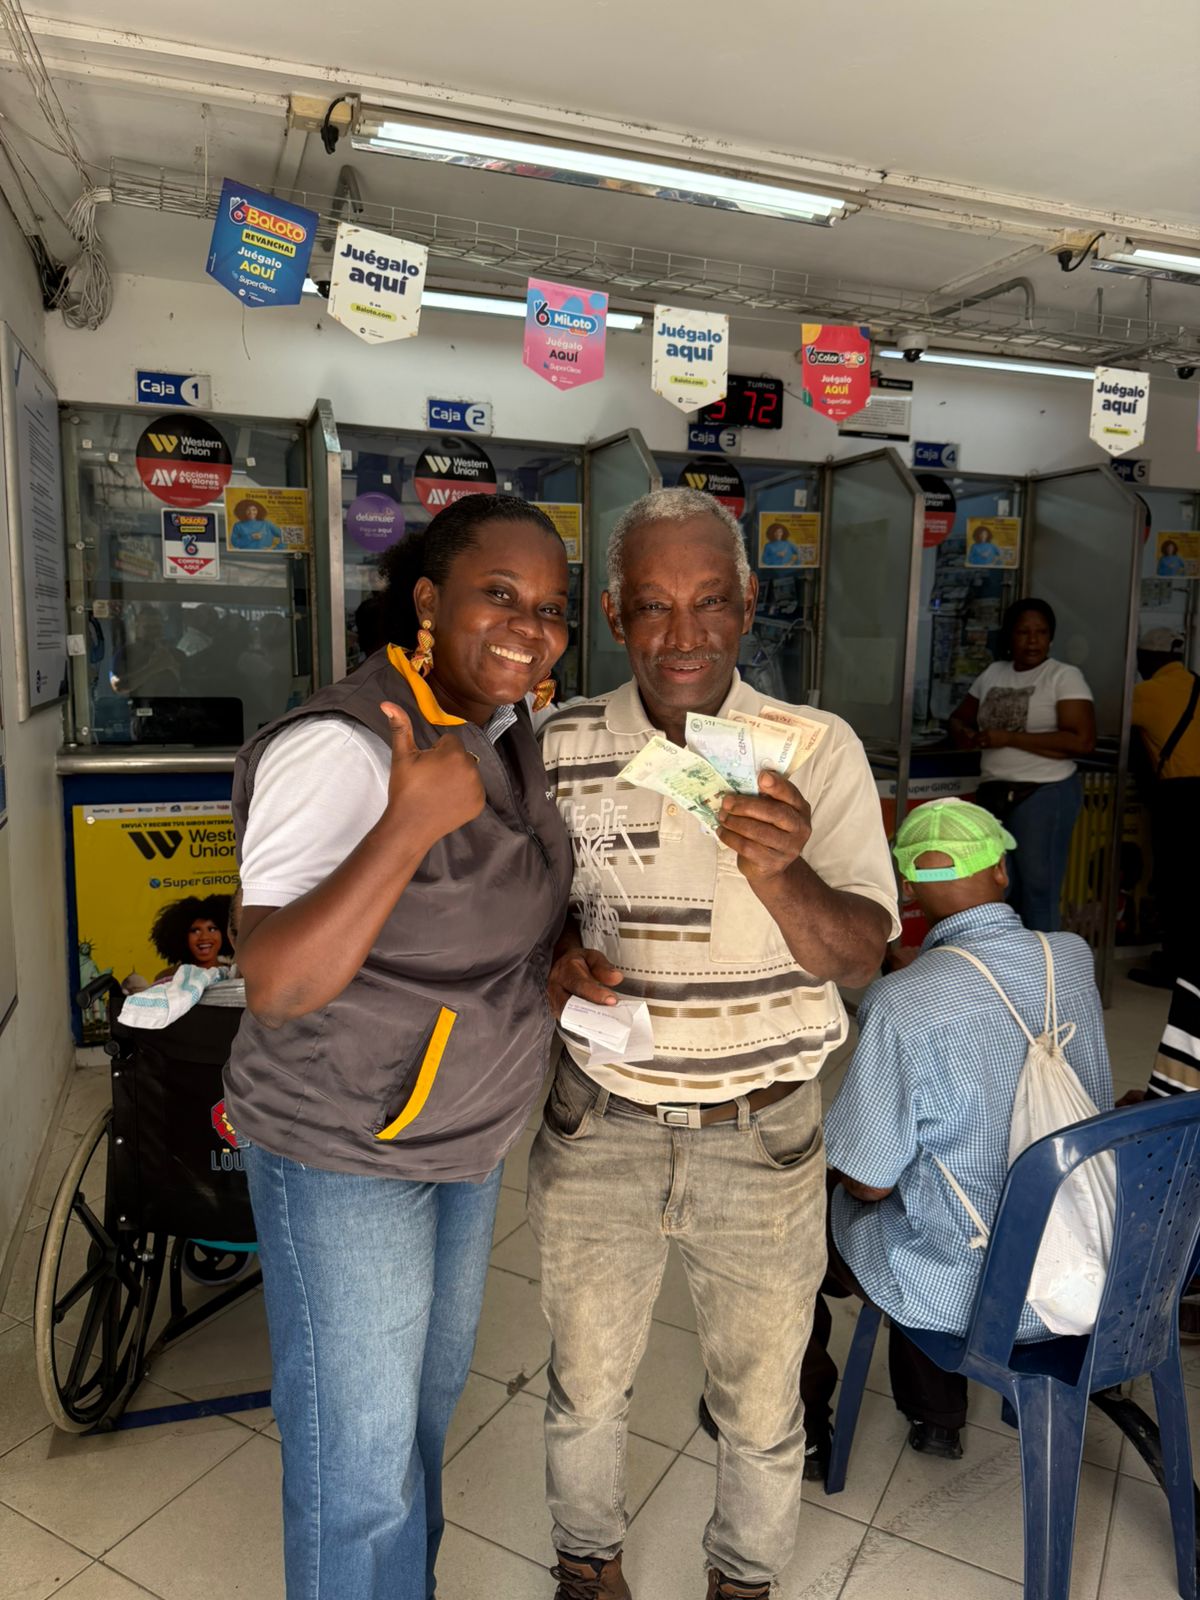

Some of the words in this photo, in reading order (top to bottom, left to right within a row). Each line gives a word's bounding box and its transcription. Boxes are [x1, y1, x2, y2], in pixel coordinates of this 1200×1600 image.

[246, 208, 304, 242] Baloto
[244, 232, 294, 255] REVANCHA!
[237, 247, 282, 269] Juégalo
[340, 243, 420, 277] Juégalo
[239, 260, 276, 280] AQUÍ
[349, 266, 409, 295] aquí
[356, 304, 393, 320] Baloto.com
[554, 313, 592, 329] MiLoto
[657, 322, 723, 343] Juégalo
[546, 337, 583, 351] Juégalo
[549, 349, 579, 363] AQUÍ
[666, 343, 715, 362] aquí
[747, 380, 776, 390] TURNO
[821, 374, 853, 385] Juégalo
[140, 379, 176, 397] Caja
[191, 383, 199, 400] 1
[824, 384, 850, 395] AQUÍ
[1097, 381, 1145, 398] Juégalo
[743, 390, 778, 424] 72
[1102, 398, 1139, 416] aquí
[431, 407, 461, 423] Caja
[472, 409, 485, 426] 2
[180, 436, 222, 449] Western
[690, 430, 716, 446] Caja
[725, 432, 737, 447] 3
[181, 445, 211, 457] Union
[916, 448, 939, 461] Caja
[946, 450, 956, 463] 4
[453, 457, 489, 469] Western
[179, 471, 219, 480] Acciones
[453, 466, 479, 477] Union
[1137, 465, 1146, 478] 5
[908, 781, 961, 794] uperGIROS
